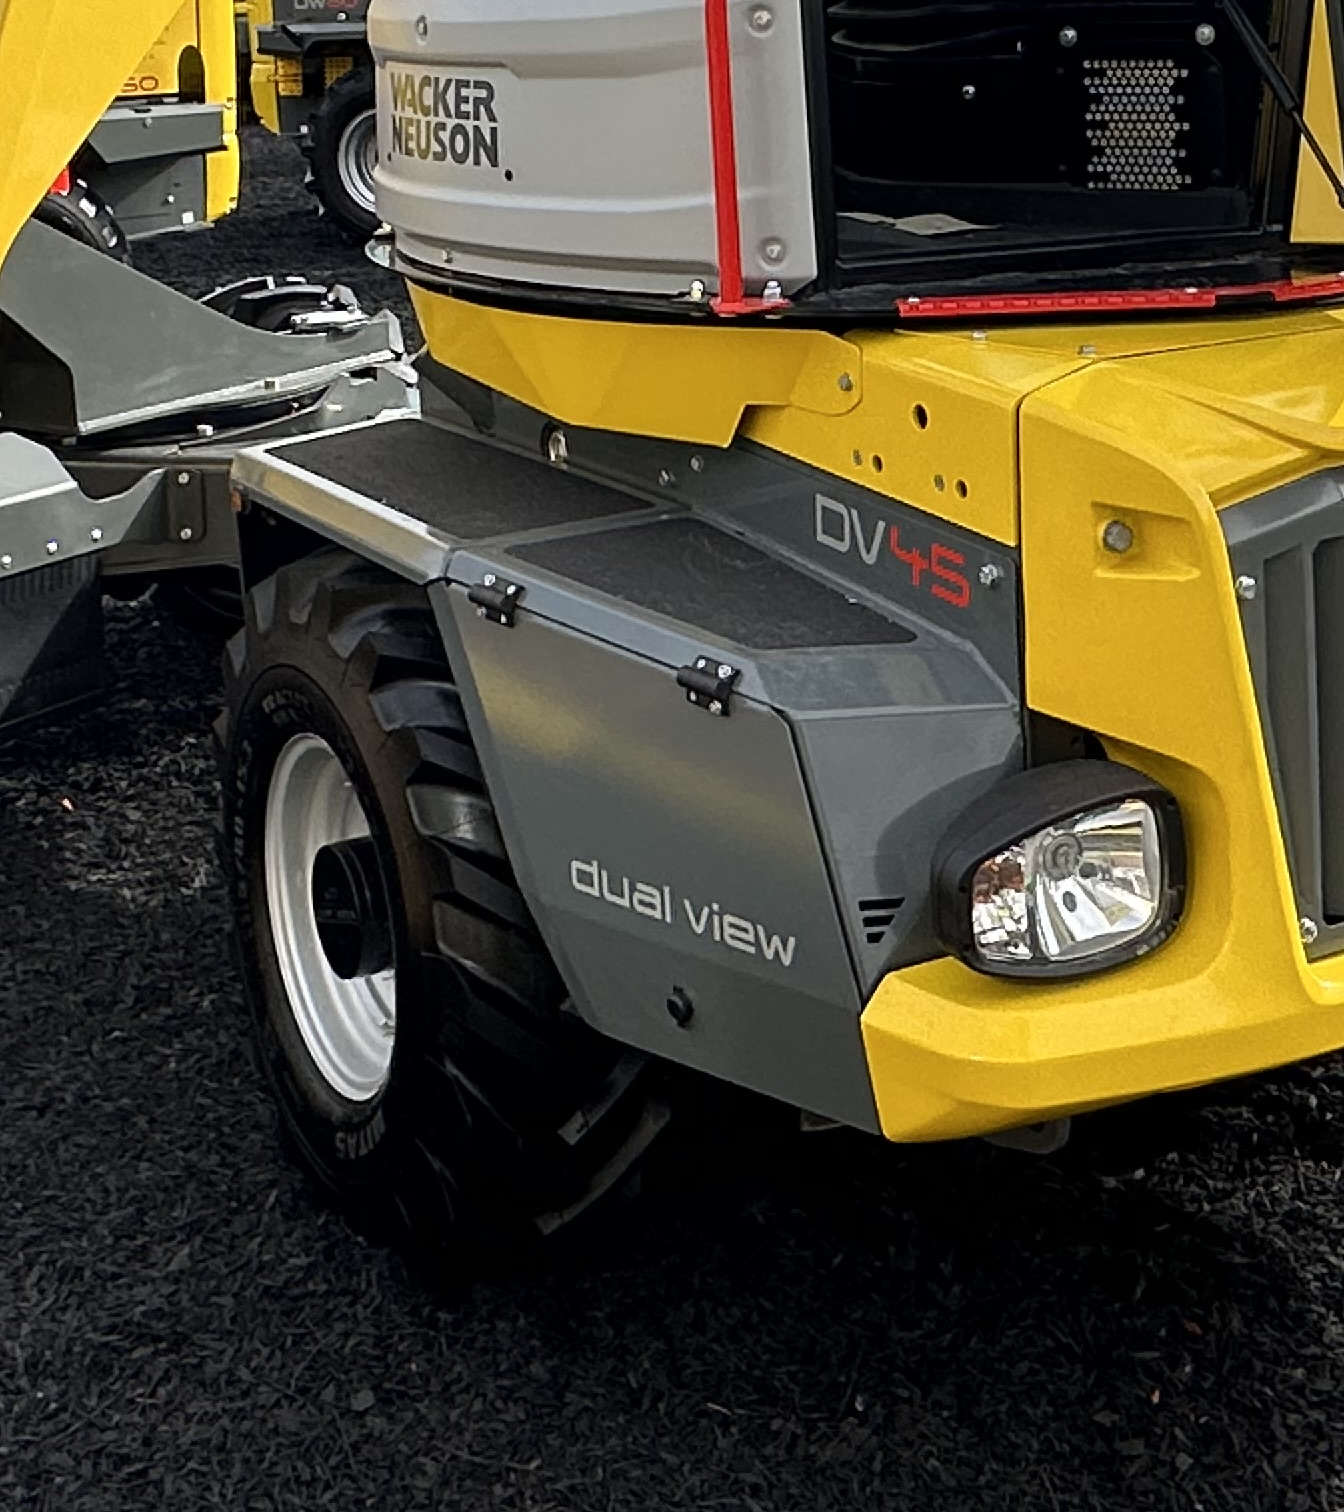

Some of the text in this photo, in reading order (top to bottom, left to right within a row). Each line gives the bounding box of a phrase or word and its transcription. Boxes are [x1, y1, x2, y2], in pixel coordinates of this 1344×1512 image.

[390, 72, 498, 123] WACKER
[391, 115, 500, 168] NEUSON
[814, 493, 973, 609] DV45
[569, 858, 797, 968] dual view
